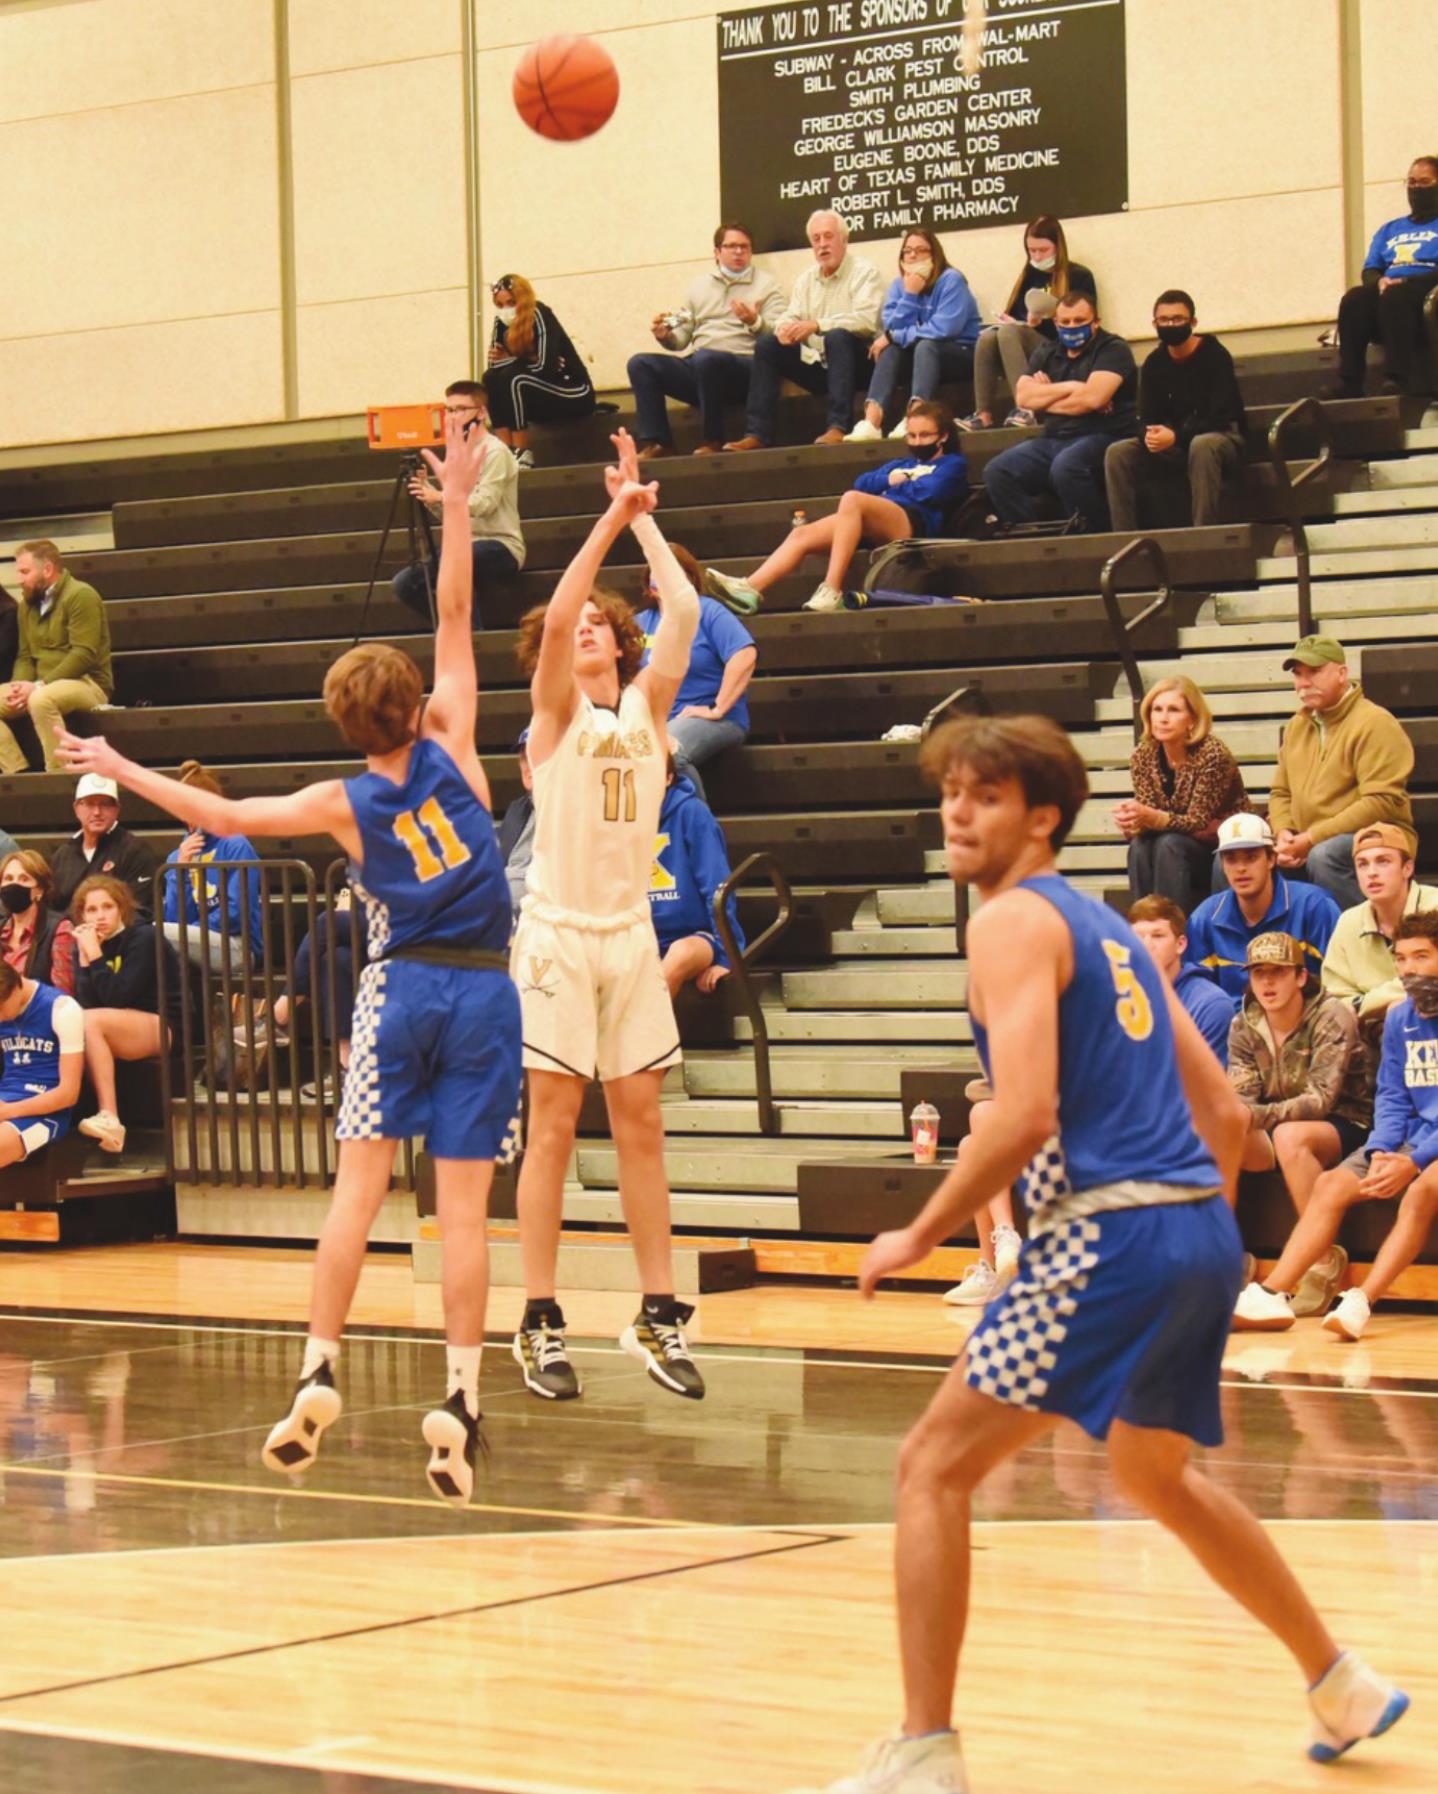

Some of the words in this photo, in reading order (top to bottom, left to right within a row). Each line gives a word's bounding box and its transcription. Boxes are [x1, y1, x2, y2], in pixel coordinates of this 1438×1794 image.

[723, 16, 764, 49] THANK
[772, 11, 797, 42] YOU
[802, 7, 819, 37] TO
[827, 3, 853, 33] THE
[860, 0, 927, 29] SPONSORS
[774, 53, 834, 77] SUBWAY
[853, 42, 913, 67] ACROSS
[922, 35, 964, 56] FROM
[803, 75, 836, 94] BILL
[845, 65, 896, 87] CLARK
[905, 58, 944, 78] PEST
[953, 47, 1029, 72] CNTROL
[849, 86, 893, 107] SMITH
[904, 74, 981, 99] PLUMBING
[895, 98, 958, 122] GARDEN
[967, 88, 1032, 111] CENTER
[794, 133, 855, 156] GEORGE
[864, 120, 954, 147] WILLIAMSON
[965, 107, 1041, 133] MASONRY
[780, 177, 831, 199] HEART
[838, 174, 858, 192] OF
[867, 167, 915, 188] TEXAS
[924, 159, 975, 181] FAMILY
[985, 148, 1060, 173] MEDICINE
[834, 149, 894, 172] EUGENE
[904, 140, 960, 163] BOONE,
[966, 135, 1000, 154] DDS
[831, 190, 890, 213] ROBERT
[916, 181, 966, 203] SMITH,
[971, 176, 1006, 196] DDS
[843, 211, 864, 231] OR
[873, 207, 923, 229] FAMILY
[933, 196, 1019, 221] PHARMACY
[602, 768, 637, 822] 11
[392, 796, 472, 884] 11
[528, 956, 553, 985] V
[1101, 939, 1154, 1041] 5
[1405, 1040, 1438, 1069] KE
